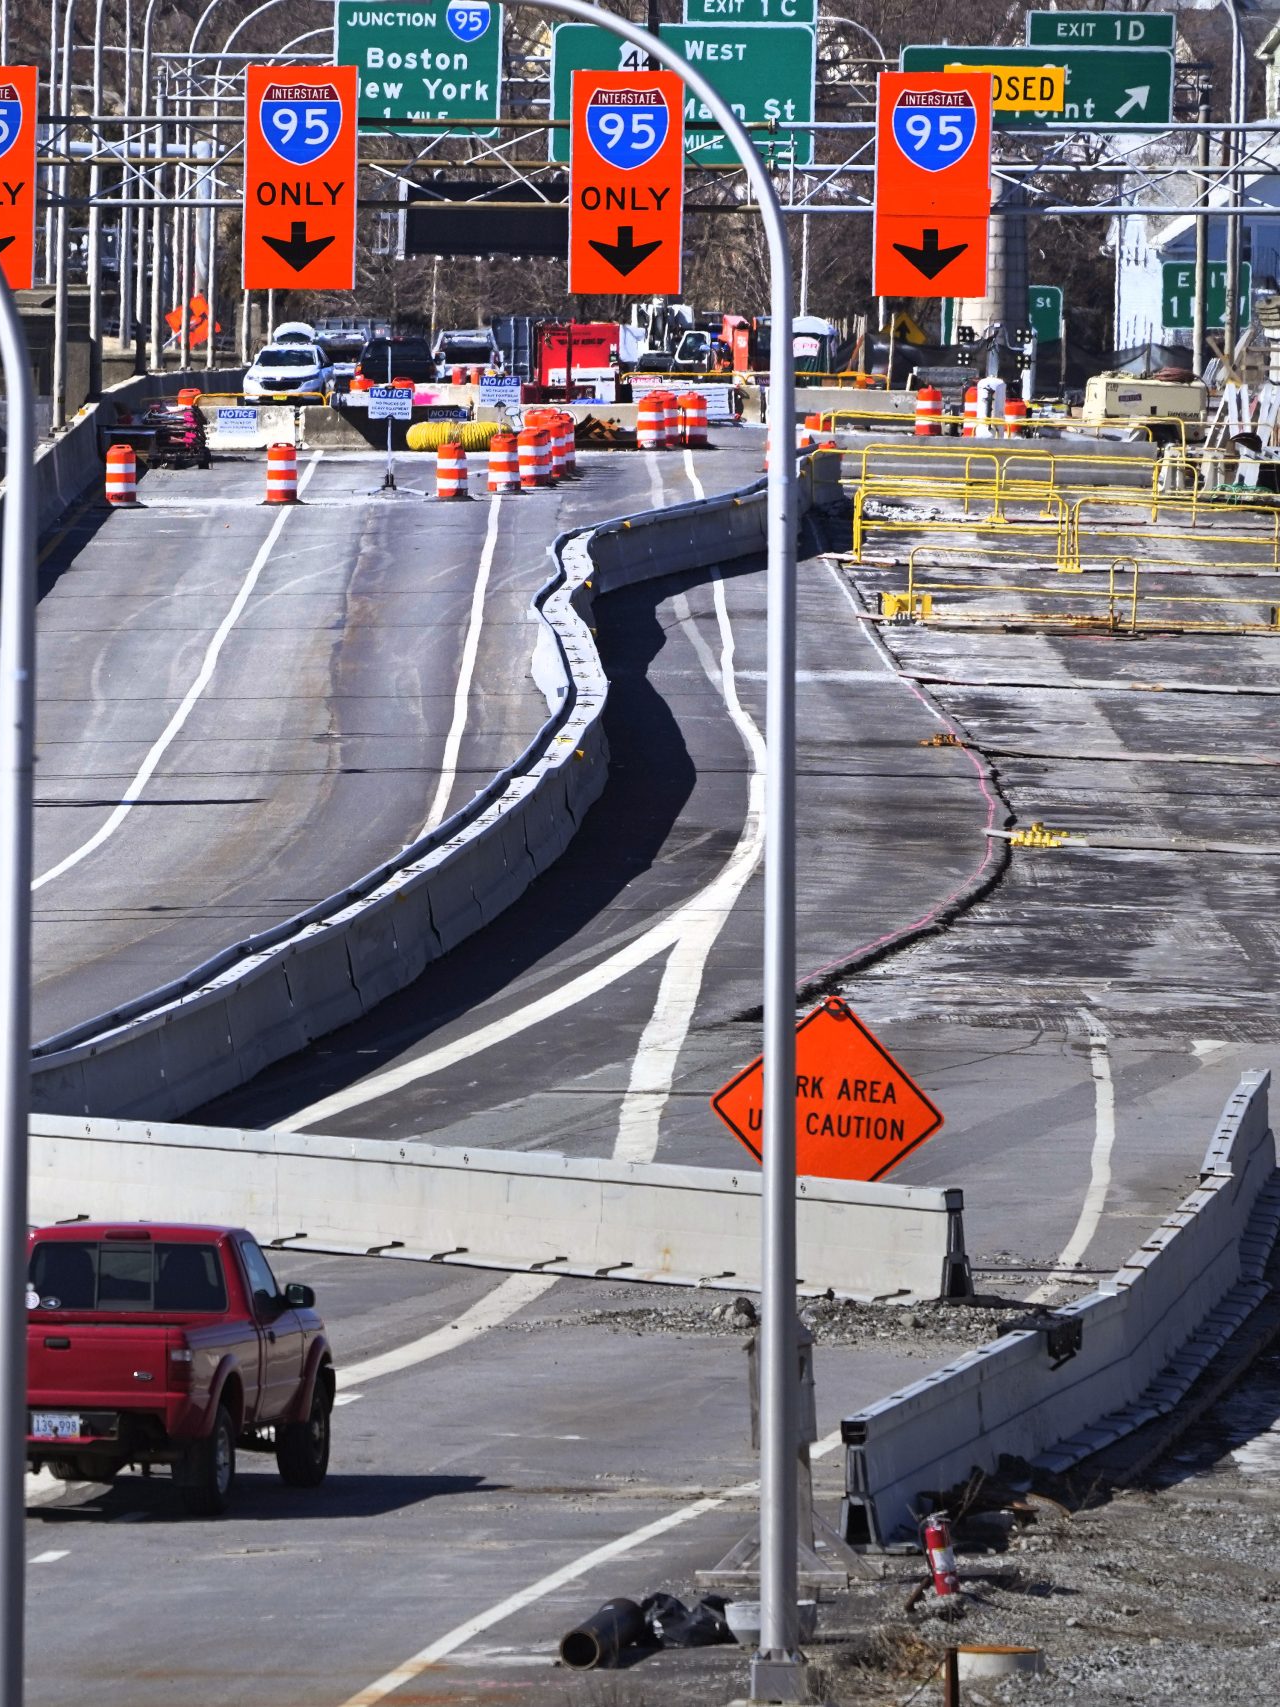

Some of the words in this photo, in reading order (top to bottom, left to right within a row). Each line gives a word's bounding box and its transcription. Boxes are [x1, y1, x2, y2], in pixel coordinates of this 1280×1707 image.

[703, 0, 744, 13] EXIT
[347, 12, 436, 27] JUNCTION
[455, 11, 482, 31] 95
[1057, 22, 1096, 37] EXIT
[1114, 20, 1145, 41] 1D
[367, 48, 468, 70] Boston
[685, 40, 747, 61] WEST
[272, 88, 330, 99] INTERSTATE
[359, 78, 403, 99] ew
[422, 79, 488, 100] York
[598, 93, 657, 104] INTERSTATE
[993, 75, 1054, 101] OSED
[684, 98, 745, 120] Man
[764, 98, 795, 120] St
[906, 95, 964, 106] INTERSTATE
[272, 108, 329, 145] 95
[598, 113, 656, 150] 95
[905, 114, 963, 152] 95
[256, 181, 345, 206] ONLY
[581, 186, 670, 211] ONLY
[1178, 272, 1227, 288] EIT
[1036, 297, 1051, 308] St
[482, 377, 518, 386] NOTICE
[372, 389, 409, 398] NOTICE
[220, 410, 255, 418] NOTICE
[431, 409, 467, 417] NOTICE
[837, 1079, 896, 1104] AREA
[806, 1112, 904, 1141] CAUTION
